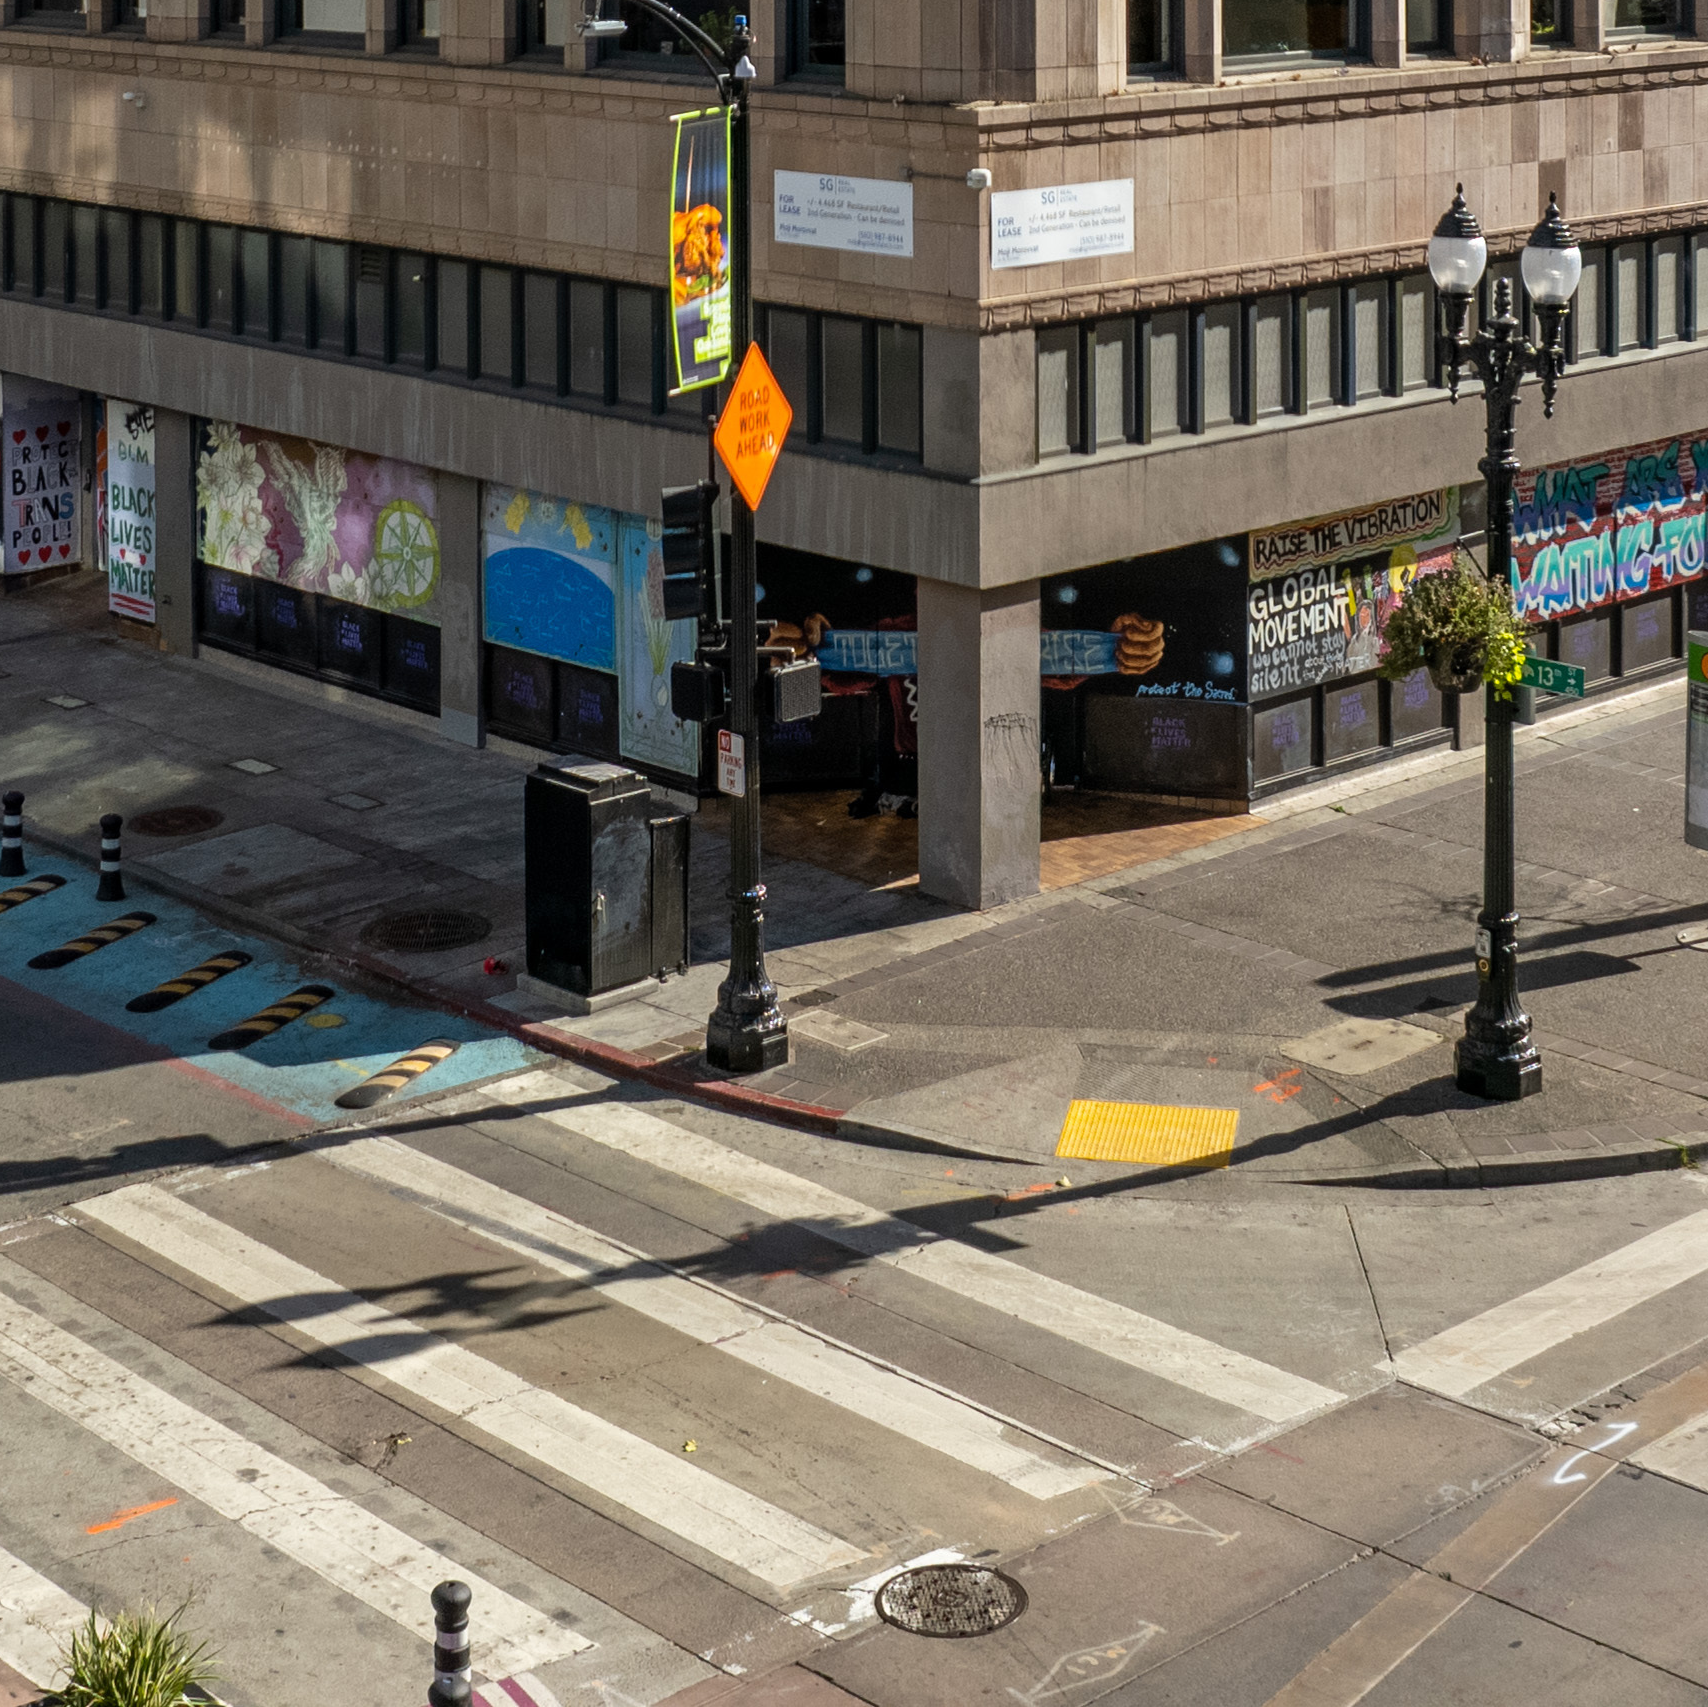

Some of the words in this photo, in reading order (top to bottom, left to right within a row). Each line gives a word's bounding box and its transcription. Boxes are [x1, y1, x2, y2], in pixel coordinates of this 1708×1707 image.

[819, 177, 834, 191] SG
[1041, 190, 1055, 205] SG
[779, 194, 794, 203] FOR
[779, 204, 801, 215] LEASE
[998, 217, 1014, 226] FOR
[998, 227, 1021, 238] LEASE
[740, 385, 770, 412] ROAD
[739, 409, 771, 434] WORK
[118, 442, 148, 466] BLM
[736, 432, 774, 460] AHEAD
[12, 462, 70, 496] BLACK
[1512, 463, 1609, 544] WHAT
[1616, 441, 1685, 518] ARE
[12, 492, 74, 527] TRANS
[111, 483, 155, 522] BLACK
[13, 521, 71, 548] PEOPLE!
[111, 517, 152, 554] LIVES
[1255, 531, 1307, 564] RAISE
[1309, 523, 1342, 552] THE
[111, 559, 155, 599] MATTER
[1512, 520, 1653, 618] WAITING
[1249, 565, 1346, 620] GLOBAL
[1248, 597, 1349, 654] MOVEMENT
[1253, 652, 1271, 667] we
[1272, 638, 1318, 666] cannot
[1322, 631, 1346, 657] stay
[1184, 682, 1203, 697] the
[1250, 659, 1301, 693] silent
[1538, 666, 1562, 687] 13th
[1568, 667, 1577, 677] ST
[720, 734, 730, 751] NO
[720, 753, 742, 770] PARKING
